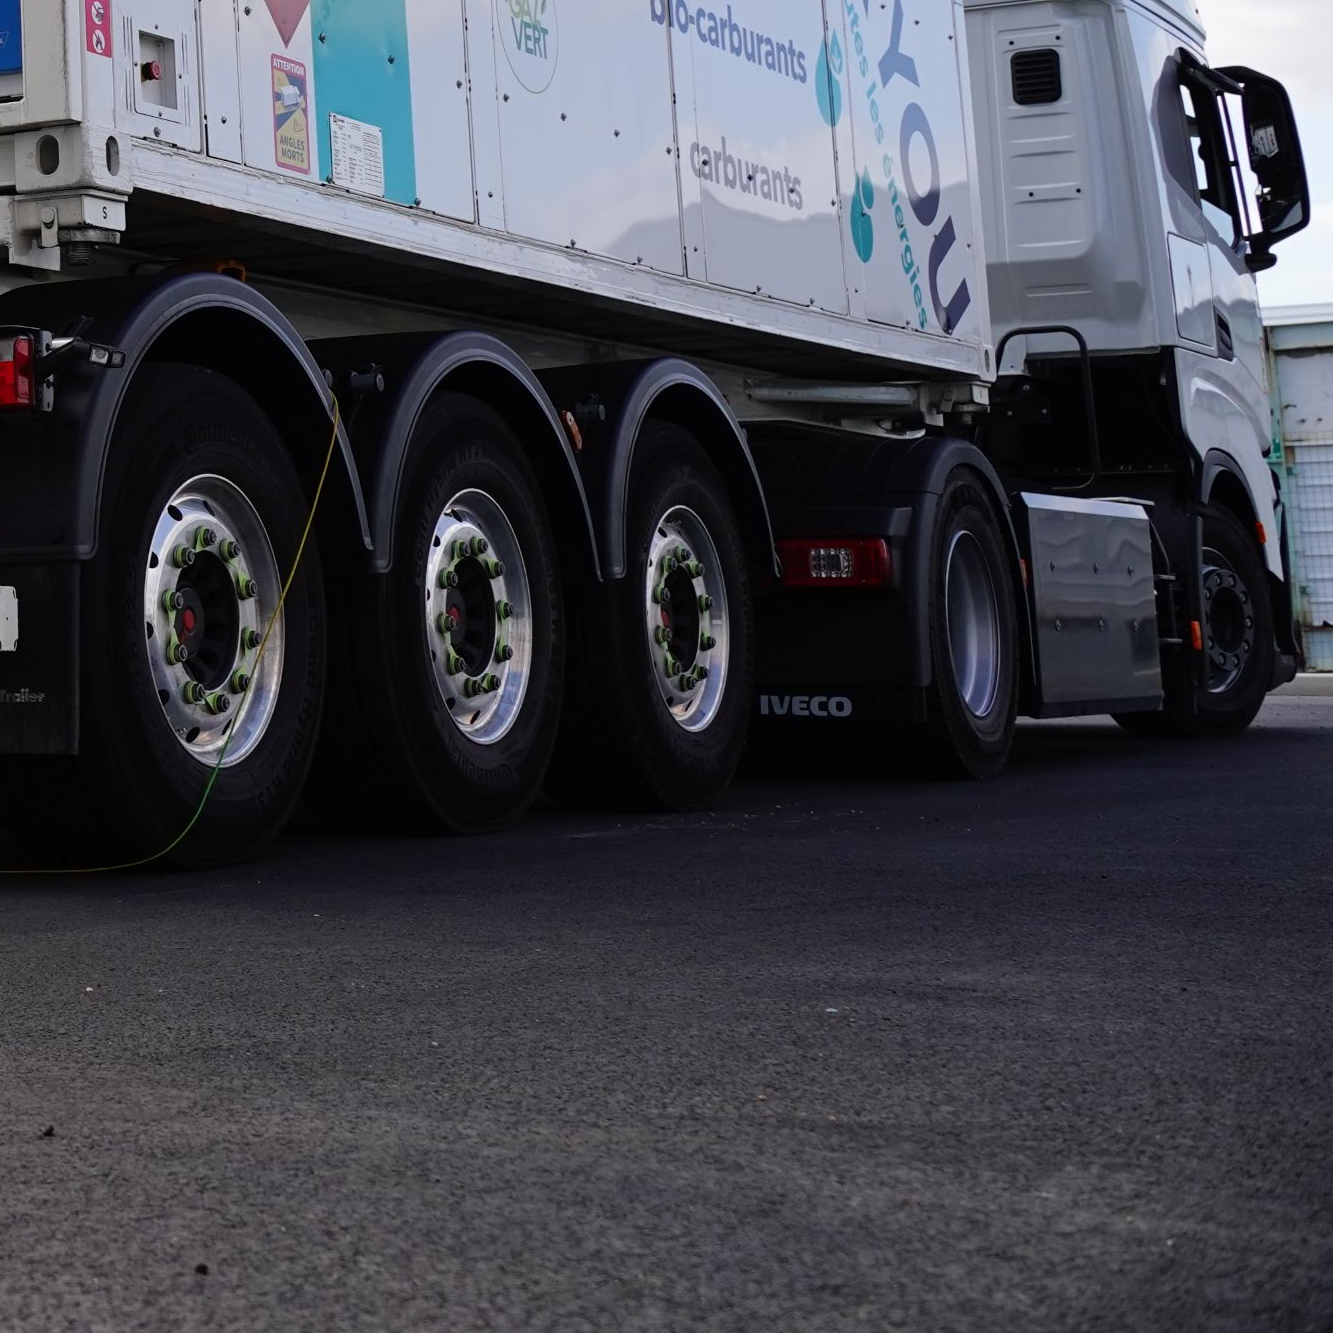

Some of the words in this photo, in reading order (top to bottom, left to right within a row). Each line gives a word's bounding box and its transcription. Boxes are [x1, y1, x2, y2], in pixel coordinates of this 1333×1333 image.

[511, 16, 549, 60] VERT
[273, 57, 305, 77] ATTENTION
[279, 134, 305, 151] ANGLES
[282, 147, 305, 163] MORTS
[690, 136, 803, 211] carburants
[102, 206, 108, 220] S
[866, 81, 885, 145] les
[883, 153, 929, 331] énergies
[760, 695, 853, 718] IVECO
